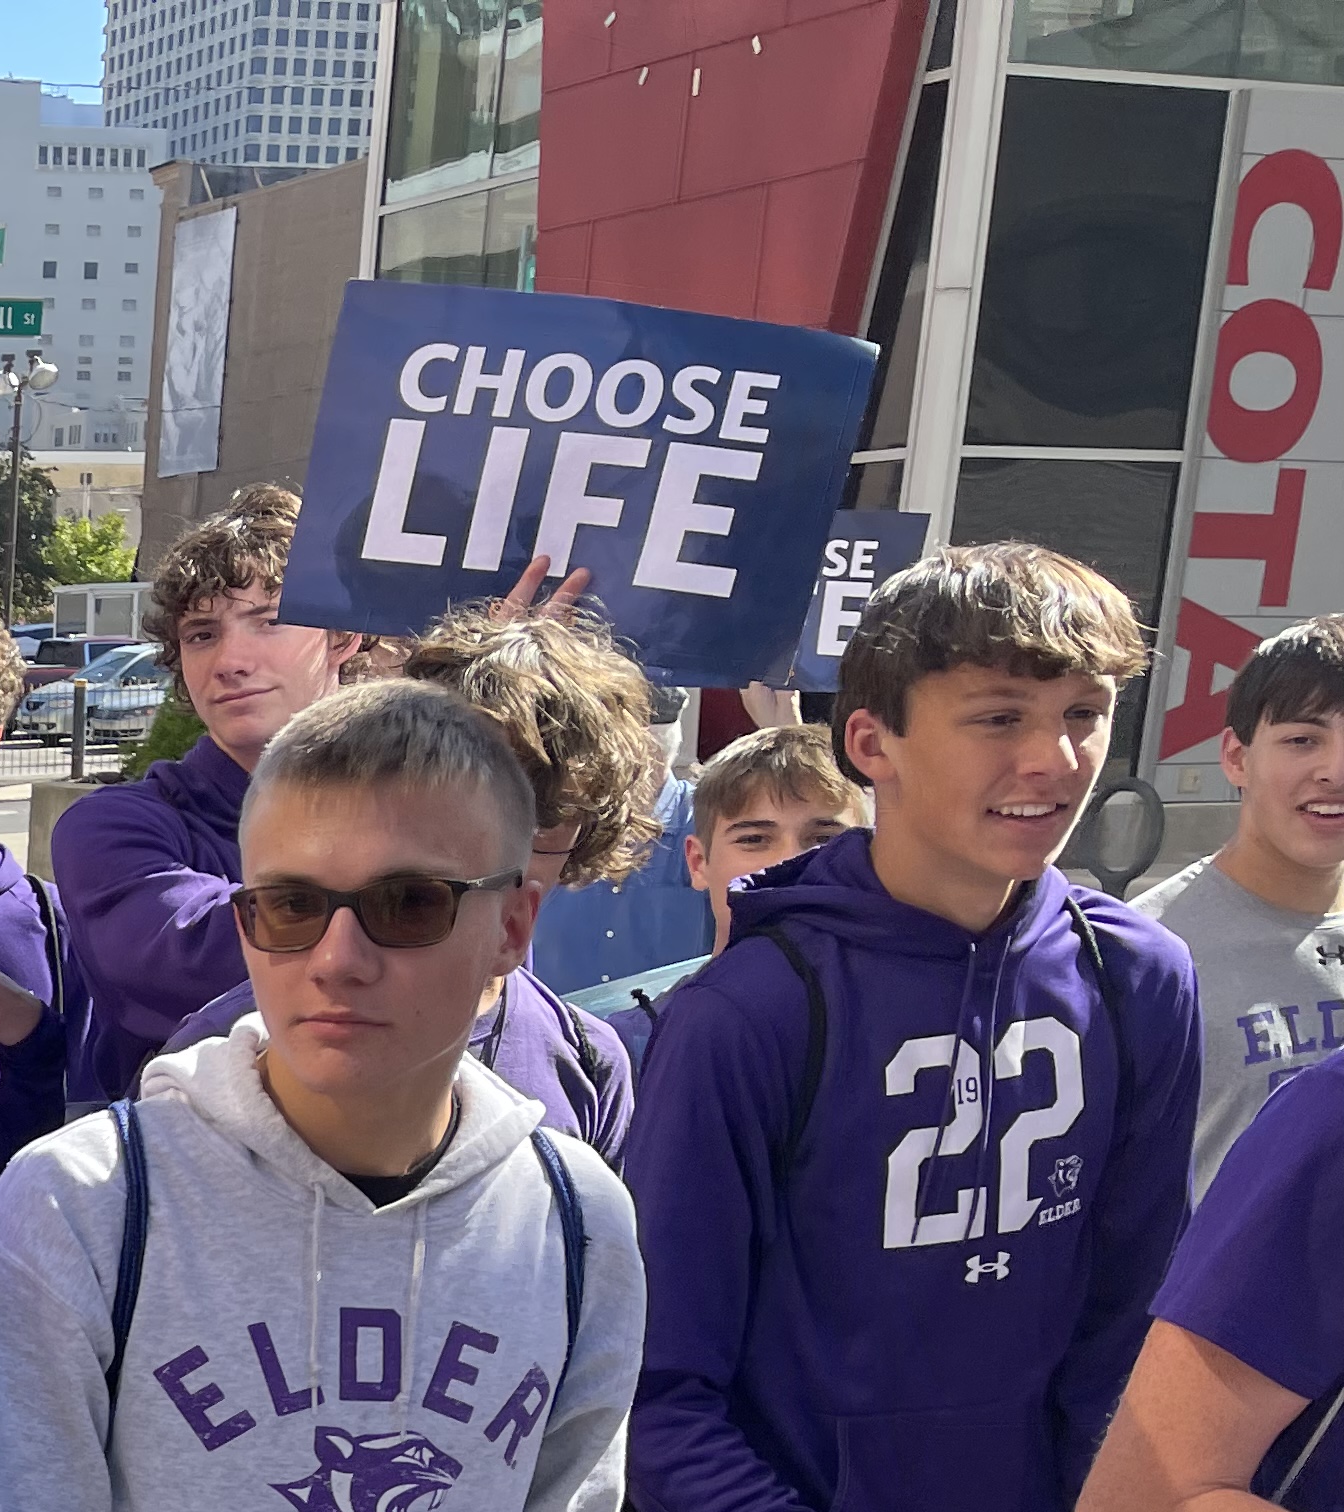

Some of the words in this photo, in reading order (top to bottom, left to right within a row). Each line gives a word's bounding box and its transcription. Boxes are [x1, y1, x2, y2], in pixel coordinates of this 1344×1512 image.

[23, 312, 36, 325] St
[398, 342, 782, 445] CHOOSE
[360, 418, 764, 599] LIFE
[1160, 148, 1343, 762] COTA
[883, 1017, 1084, 1249] 22
[955, 1076, 979, 1105] 19
[153, 1307, 553, 1470] ELDER
